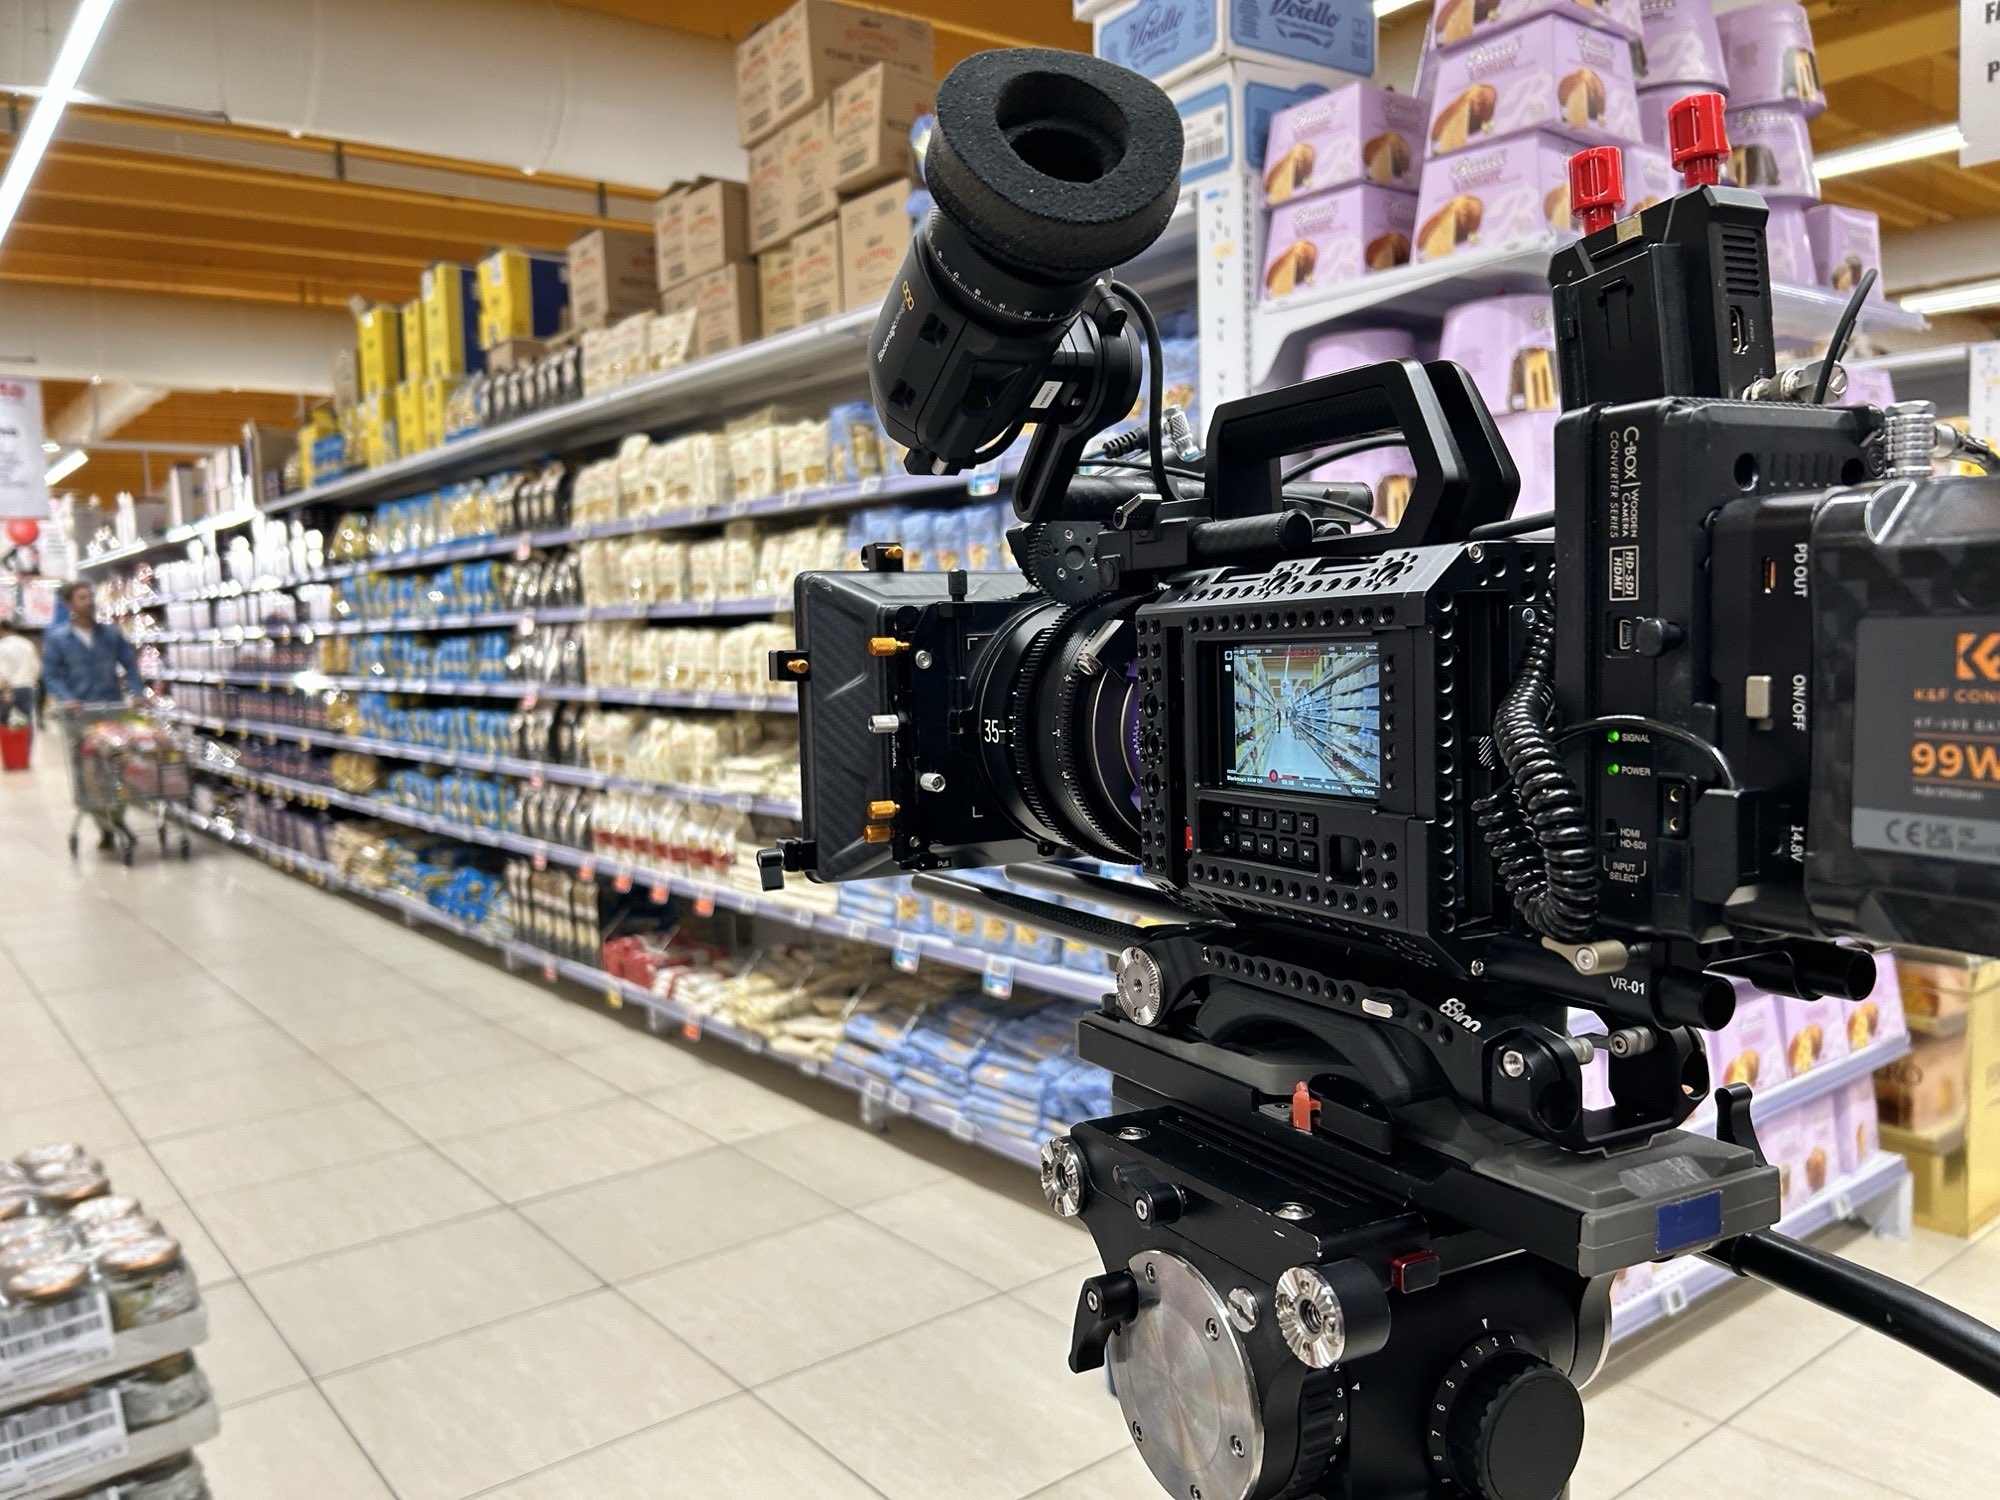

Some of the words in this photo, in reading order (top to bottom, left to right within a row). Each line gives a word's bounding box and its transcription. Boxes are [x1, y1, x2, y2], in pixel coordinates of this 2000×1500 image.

[1623, 426, 1640, 480] C-BOX
[1610, 431, 1620, 498] CONVERTER
[1622, 492, 1631, 538] CAMERA
[1630, 488, 1640, 538] WOODEN
[1610, 503, 1620, 539] SERIES
[1794, 543, 1808, 564] PD
[1613, 557, 1623, 591] HDMI
[1625, 551, 1635, 595] HD-SDI
[1794, 564, 1808, 598] OUT
[1792, 674, 1807, 731] ON/OFF
[984, 719, 999, 743] 35
[1622, 733, 1650, 742] SIGNAL
[1621, 766, 1651, 776] POWER
[1620, 828, 1640, 838] HDMI
[1620, 839, 1647, 850] HD-SDI
[1790, 825, 1804, 862] 14.8V
[1612, 862, 1636, 872] INPUT
[1609, 871, 1639, 883] SELECT
[1610, 976, 1645, 995] VR-01
[1492, 1337, 1499, 1346] 2
[1510, 1335, 1515, 1344] 1
[1475, 1345, 1483, 1355] 3
[1460, 1360, 1468, 1368] 4
[1446, 1380, 1455, 1389] 5
[1336, 1388, 1343, 1398] 3
[1436, 1403, 1446, 1412] 6
[1337, 1412, 1345, 1422] 4
[1335, 1436, 1342, 1444] 5
